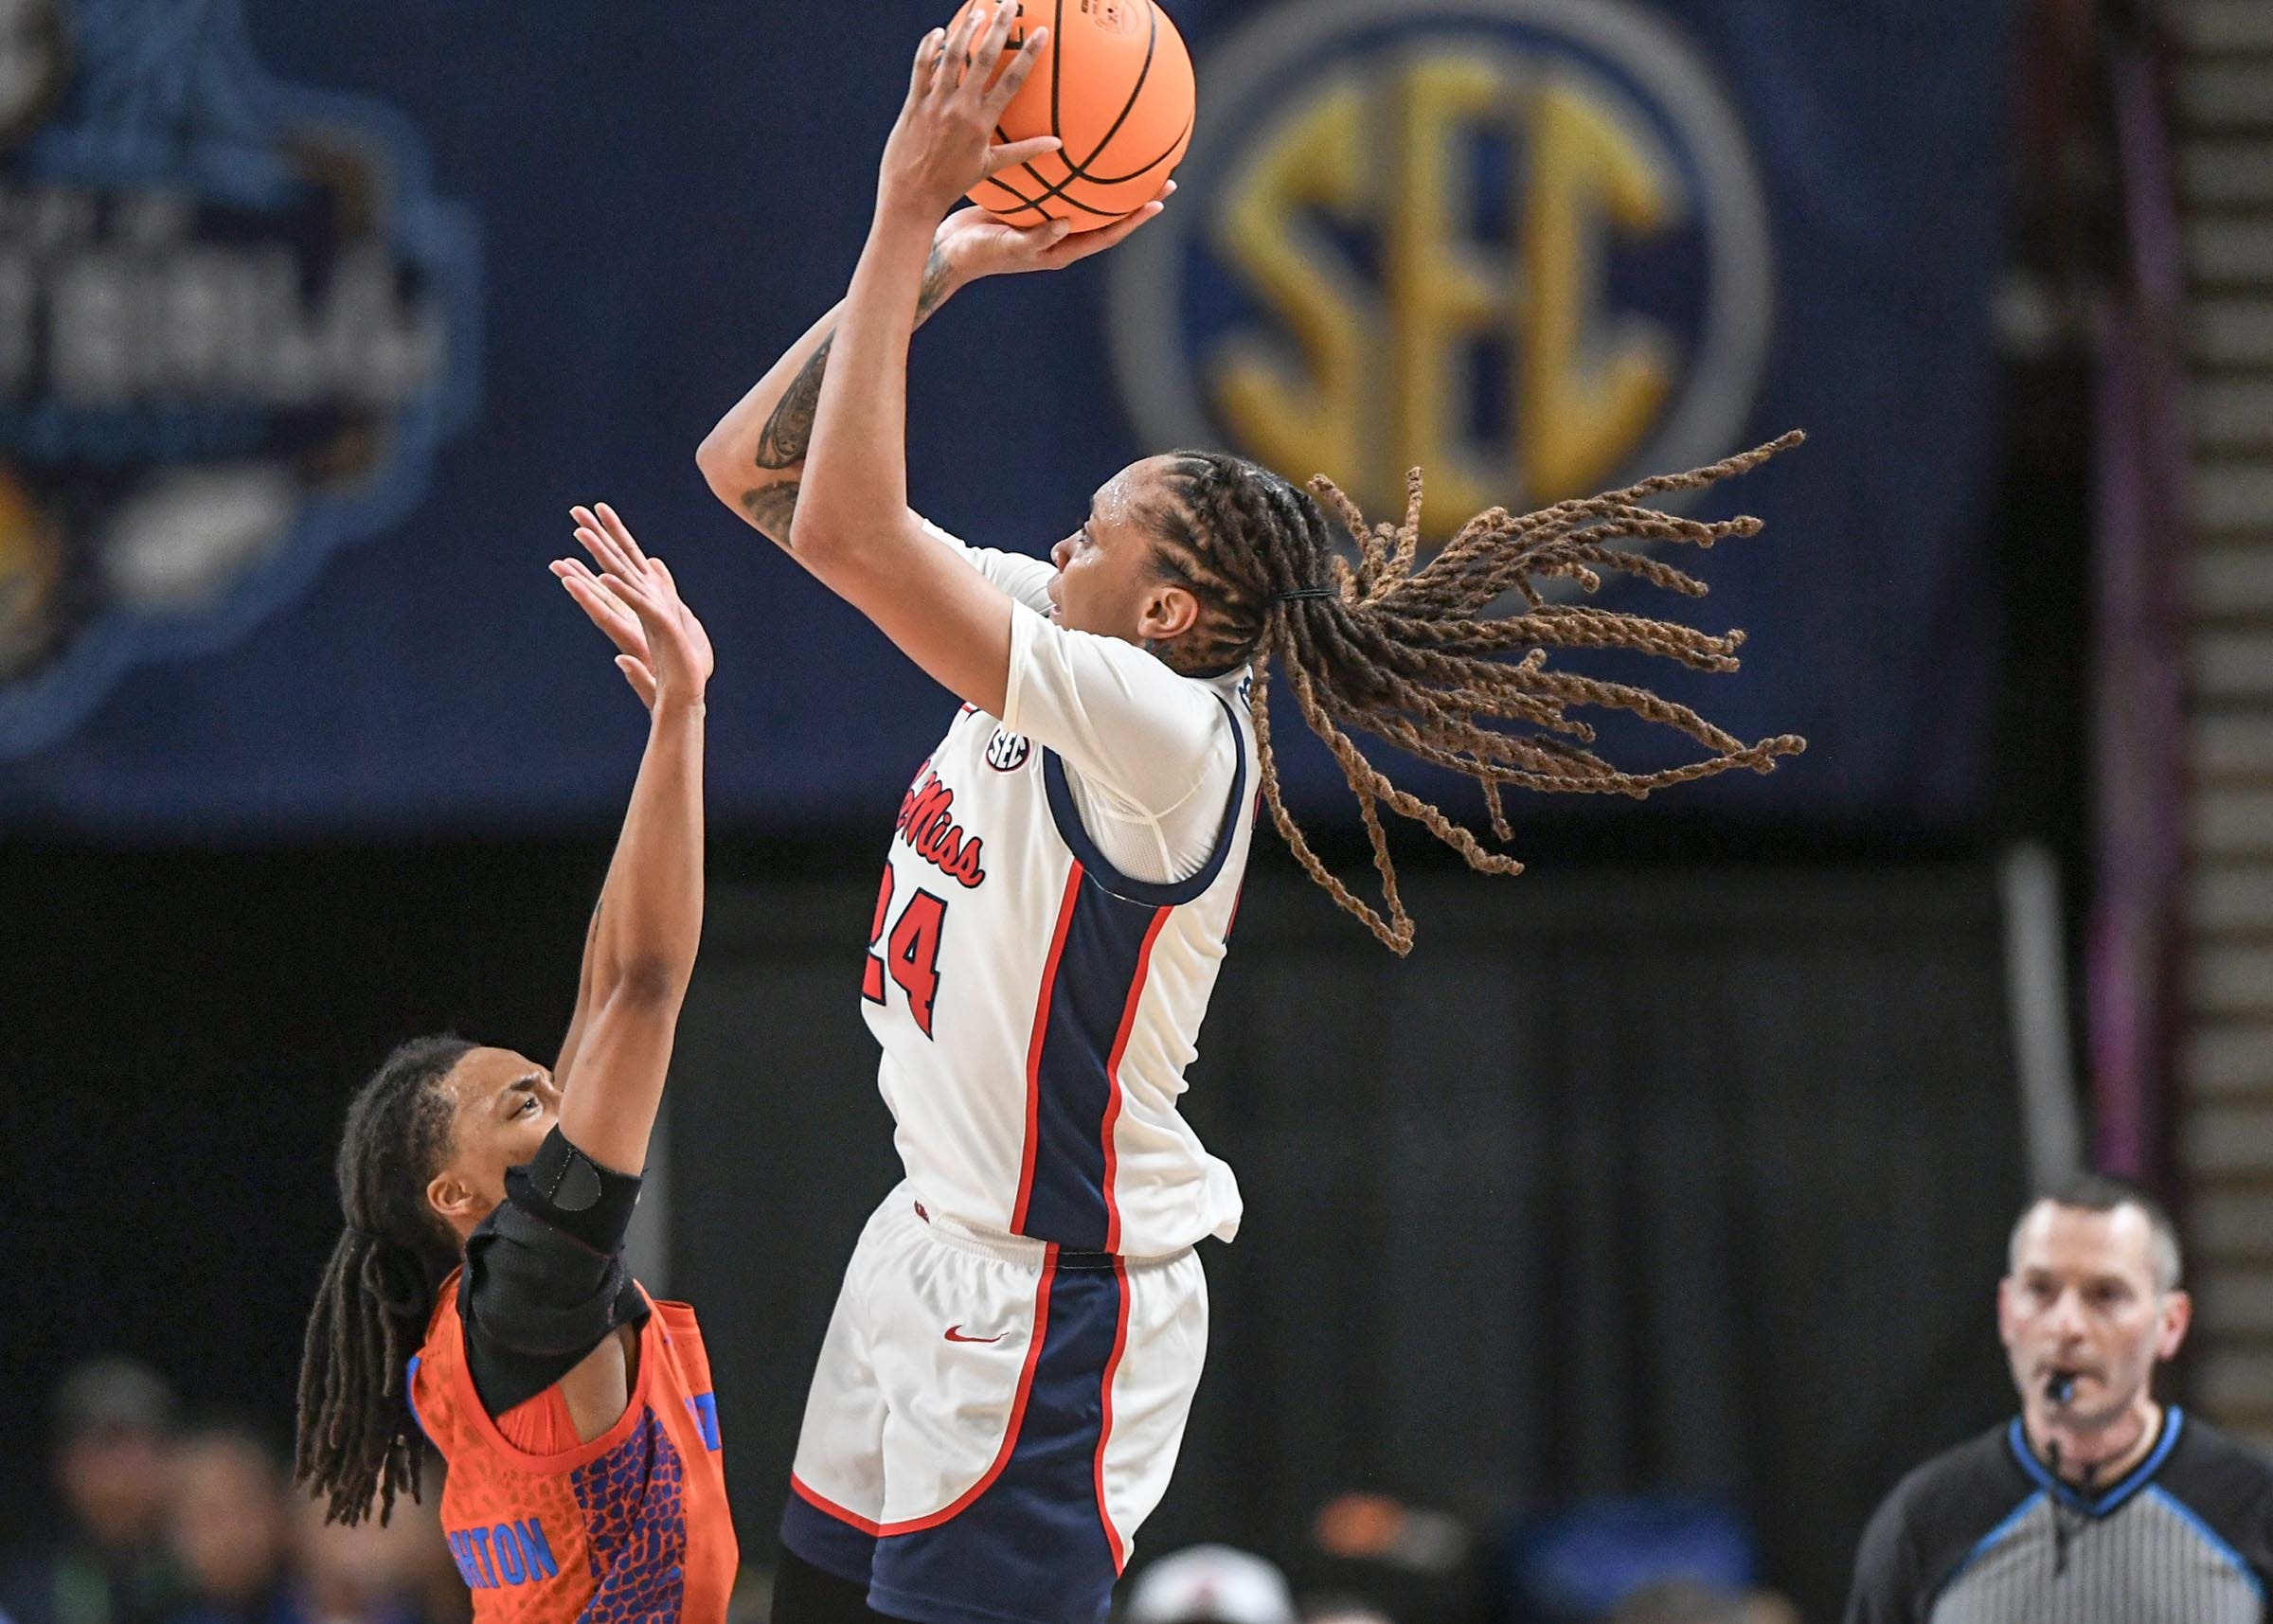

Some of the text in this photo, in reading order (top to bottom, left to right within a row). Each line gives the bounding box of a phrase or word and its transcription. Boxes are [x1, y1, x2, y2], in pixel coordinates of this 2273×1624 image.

[1208, 55, 1684, 538] SEC
[988, 728, 1027, 769] SEC
[449, 1517, 560, 1589] HTON
